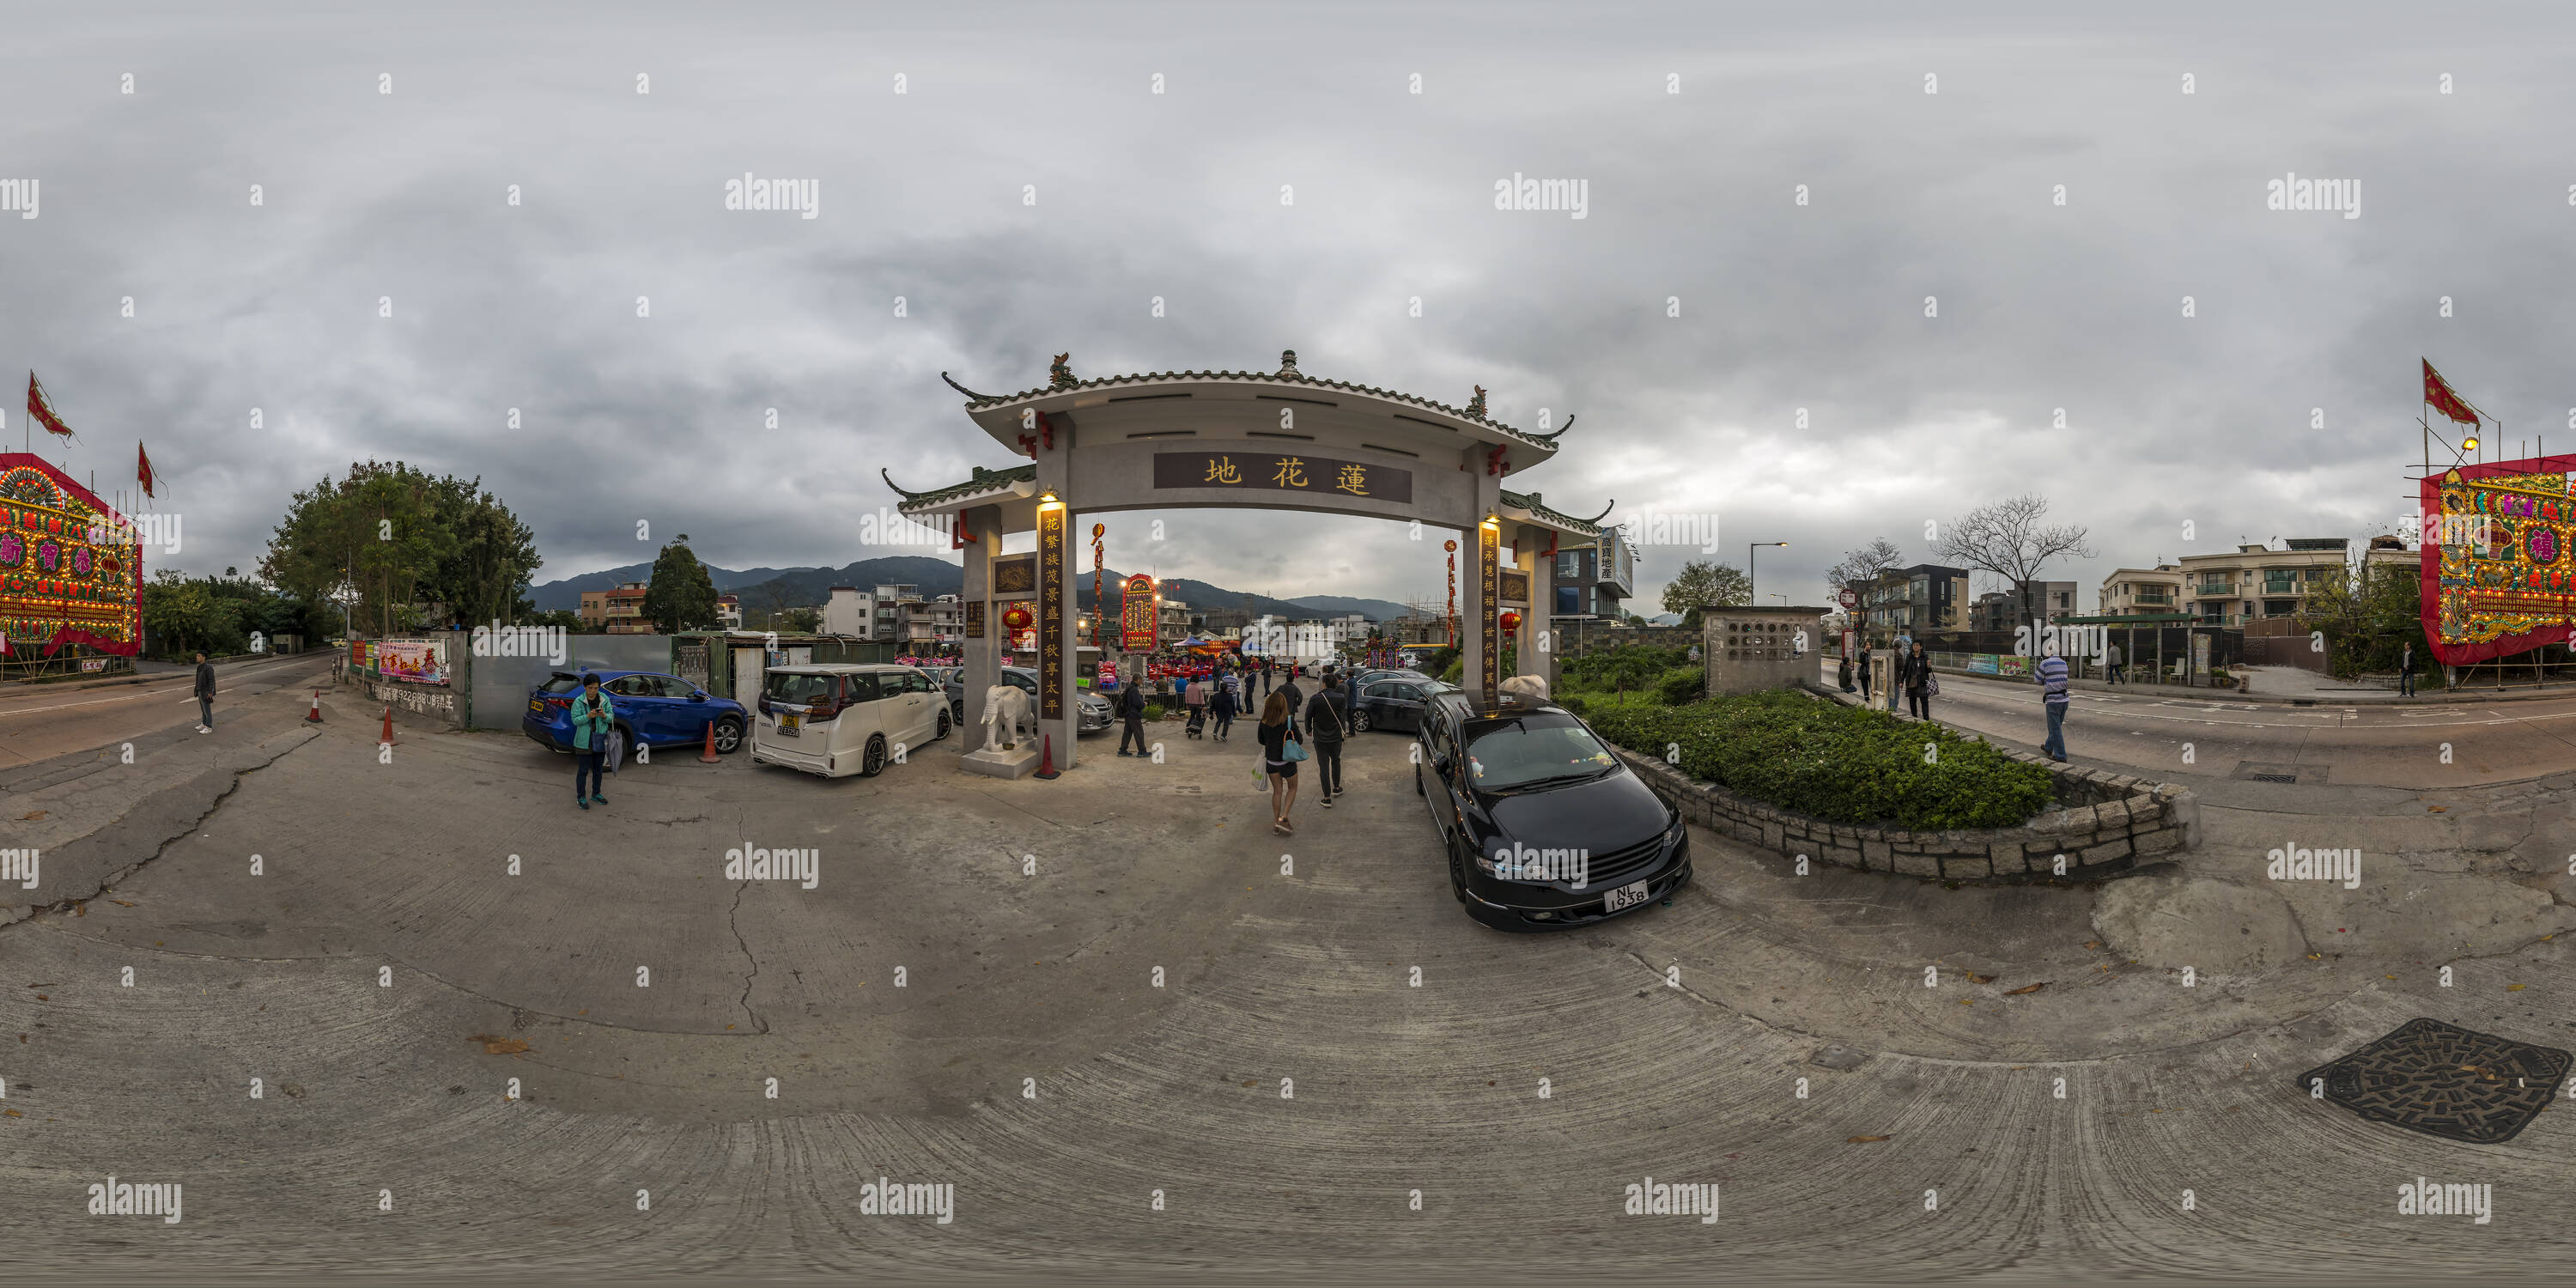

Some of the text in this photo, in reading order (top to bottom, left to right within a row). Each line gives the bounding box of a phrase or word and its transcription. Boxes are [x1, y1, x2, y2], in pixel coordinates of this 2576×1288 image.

[1204, 455, 1370, 495] 蓮花地
[1601, 538, 1612, 579] 高寶地產
[2530, 528, 2556, 562] 禧
[1044, 517, 1060, 715] 花繁族茂景盛千秋享太平
[1612, 891, 1644, 910] 1938
[1617, 886, 1636, 898] NL
